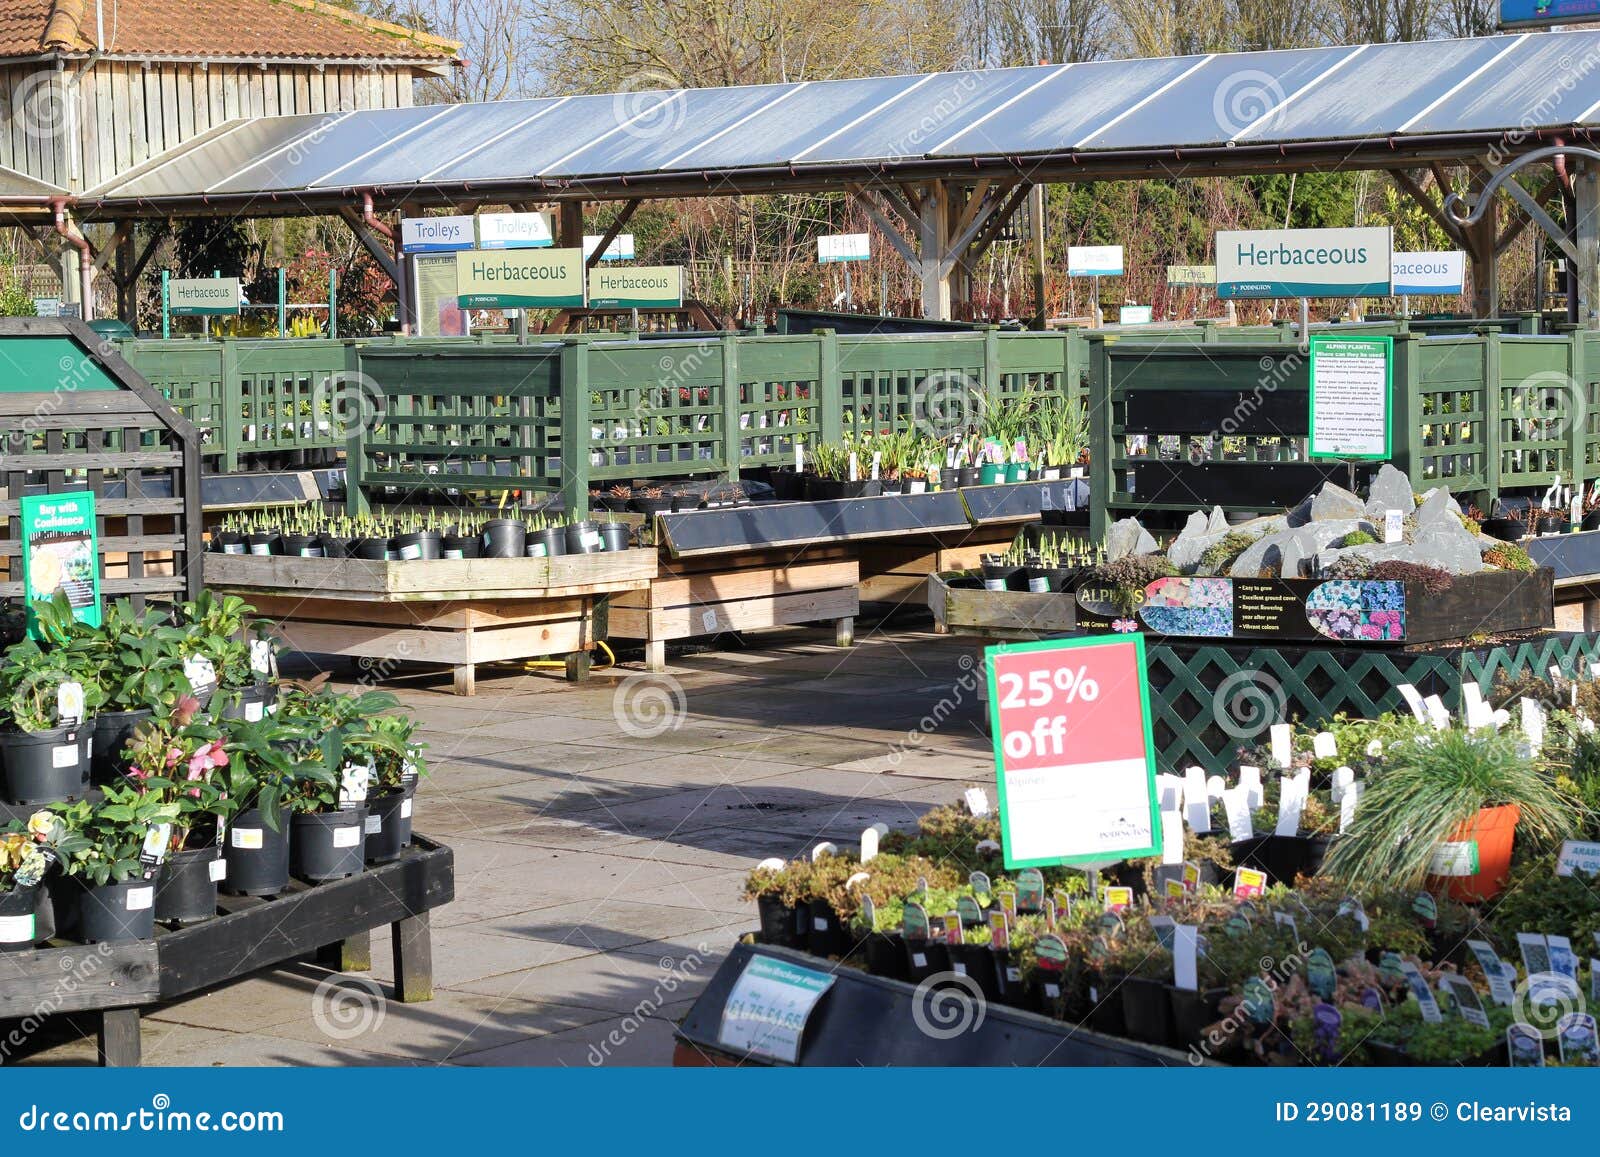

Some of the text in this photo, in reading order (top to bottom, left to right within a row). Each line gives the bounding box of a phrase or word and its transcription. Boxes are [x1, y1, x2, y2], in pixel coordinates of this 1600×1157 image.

[416, 222, 460, 240] Trolleys
[496, 218, 538, 235] Trolleys
[1238, 243, 1367, 266] Herbaceous
[473, 261, 567, 281] Herbaceous
[600, 275, 668, 290] Herbaceous
[178, 286, 230, 299] Herbaceous
[40, 502, 78, 516] Buy with
[34, 516, 84, 529] Confidence
[999, 665, 1099, 709] 25%
[1003, 715, 1067, 759] off
